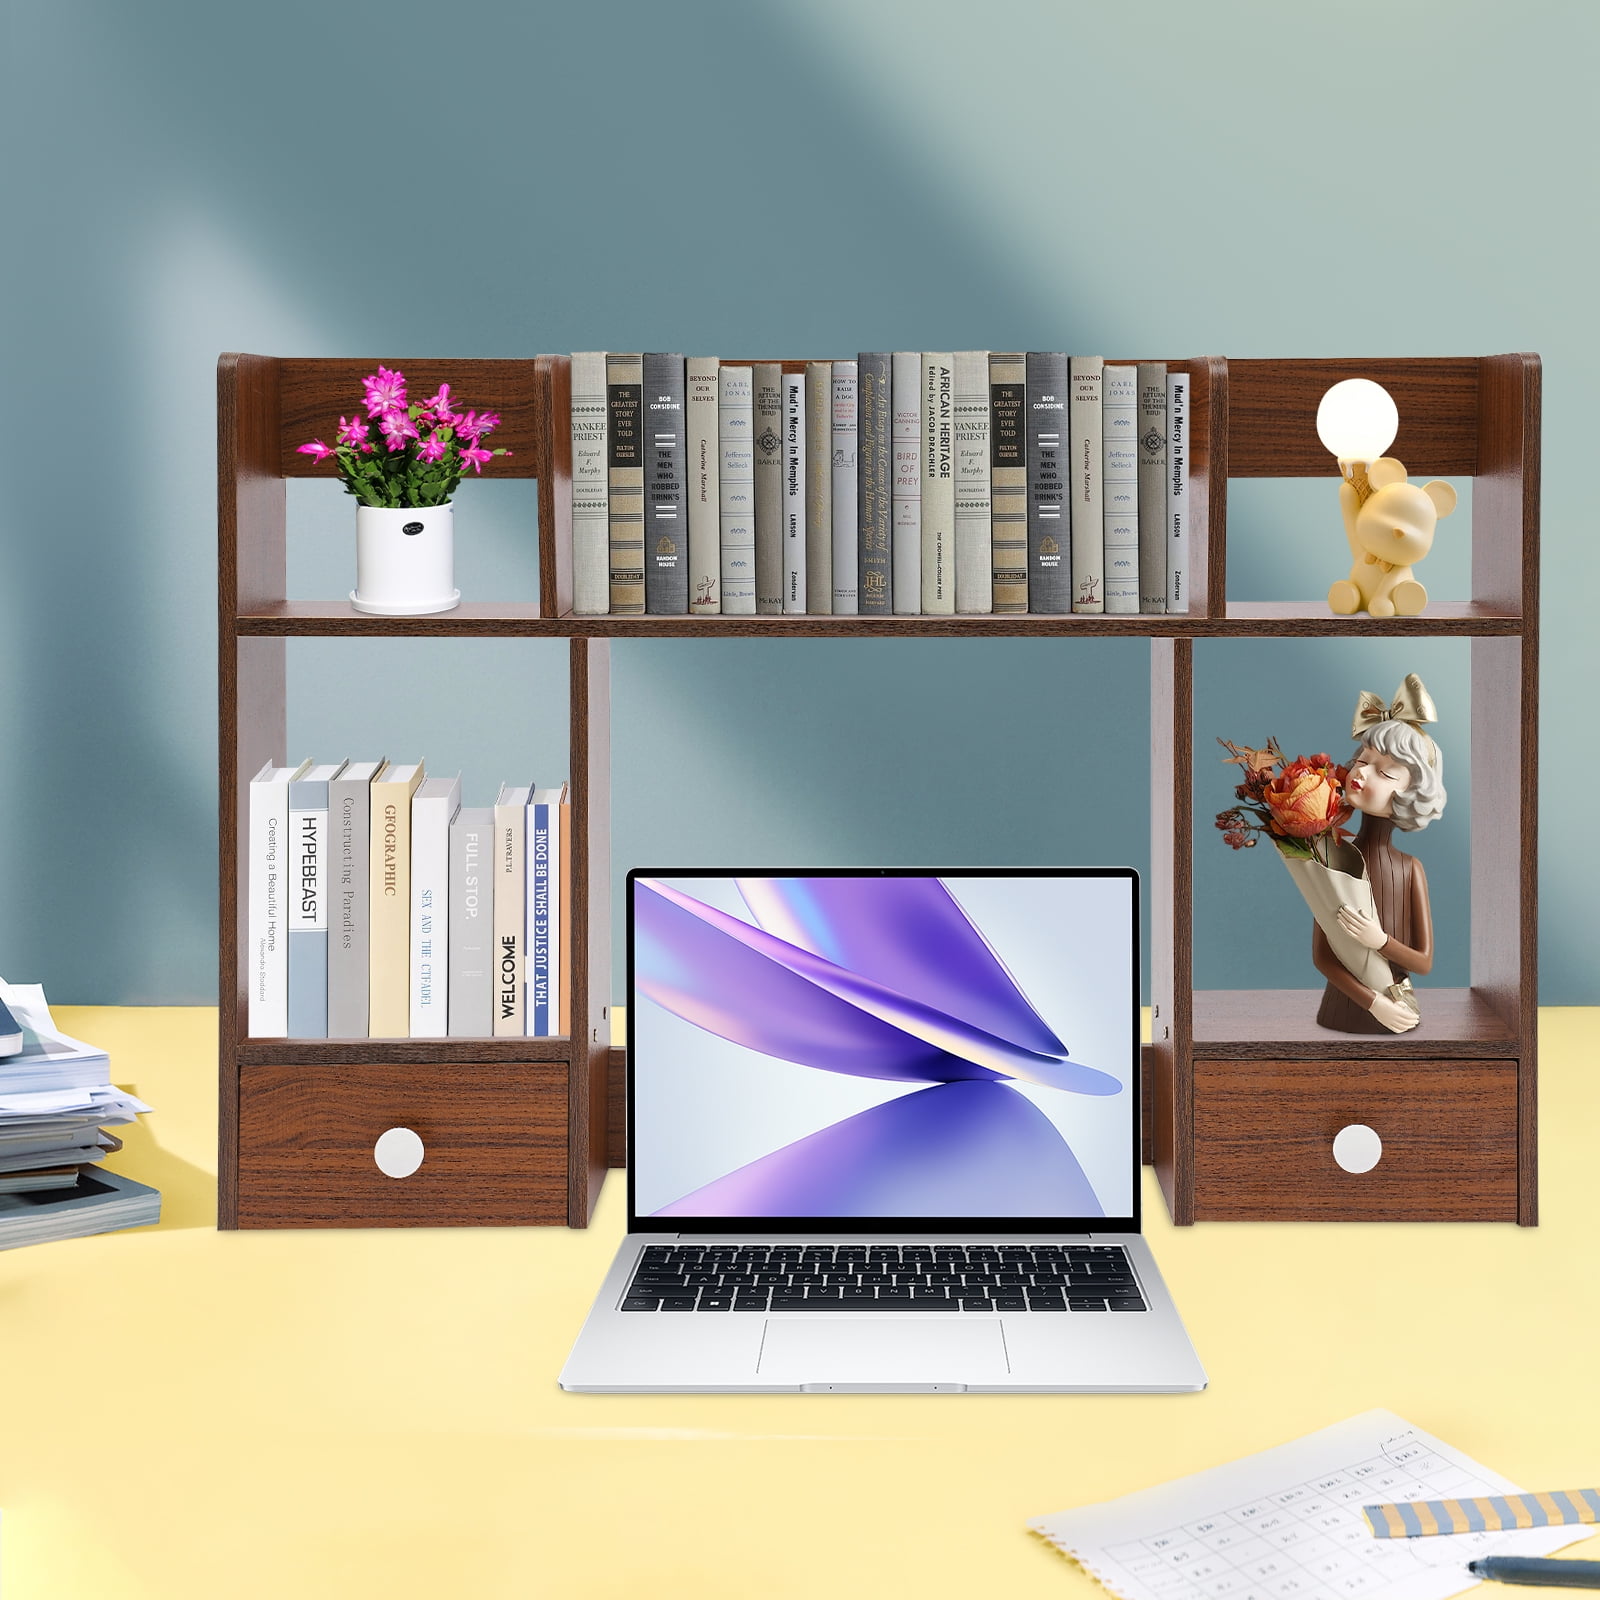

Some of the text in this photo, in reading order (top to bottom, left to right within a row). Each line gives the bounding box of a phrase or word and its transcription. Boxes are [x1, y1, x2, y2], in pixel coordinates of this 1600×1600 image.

[790, 386, 798, 413] Mud'n
[927, 394, 935, 403] by
[1174, 385, 1183, 413] Mud'n
[572, 422, 606, 430] YANKEE
[788, 417, 798, 443] Mercy
[940, 367, 950, 478] AFRICAN HERITAGE
[1173, 417, 1183, 443] Mercy
[788, 457, 798, 496] Memphis
[1173, 457, 1183, 496] Memphis
[267, 818, 277, 861] Creating
[302, 817, 317, 922] HYPEBEAST
[342, 797, 354, 949] Constructing Paradies
[466, 833, 478, 919] FULL STOP.
[268, 874, 277, 918] Beautiful
[422, 890, 432, 908] SEX
[422, 915, 432, 934] AND
[536, 829, 548, 1007] THAT JUSTICE SHALL BE DONE
[268, 922, 277, 951] Home
[421, 940, 431, 958] THE
[502, 936, 515, 1019] WELCOME
